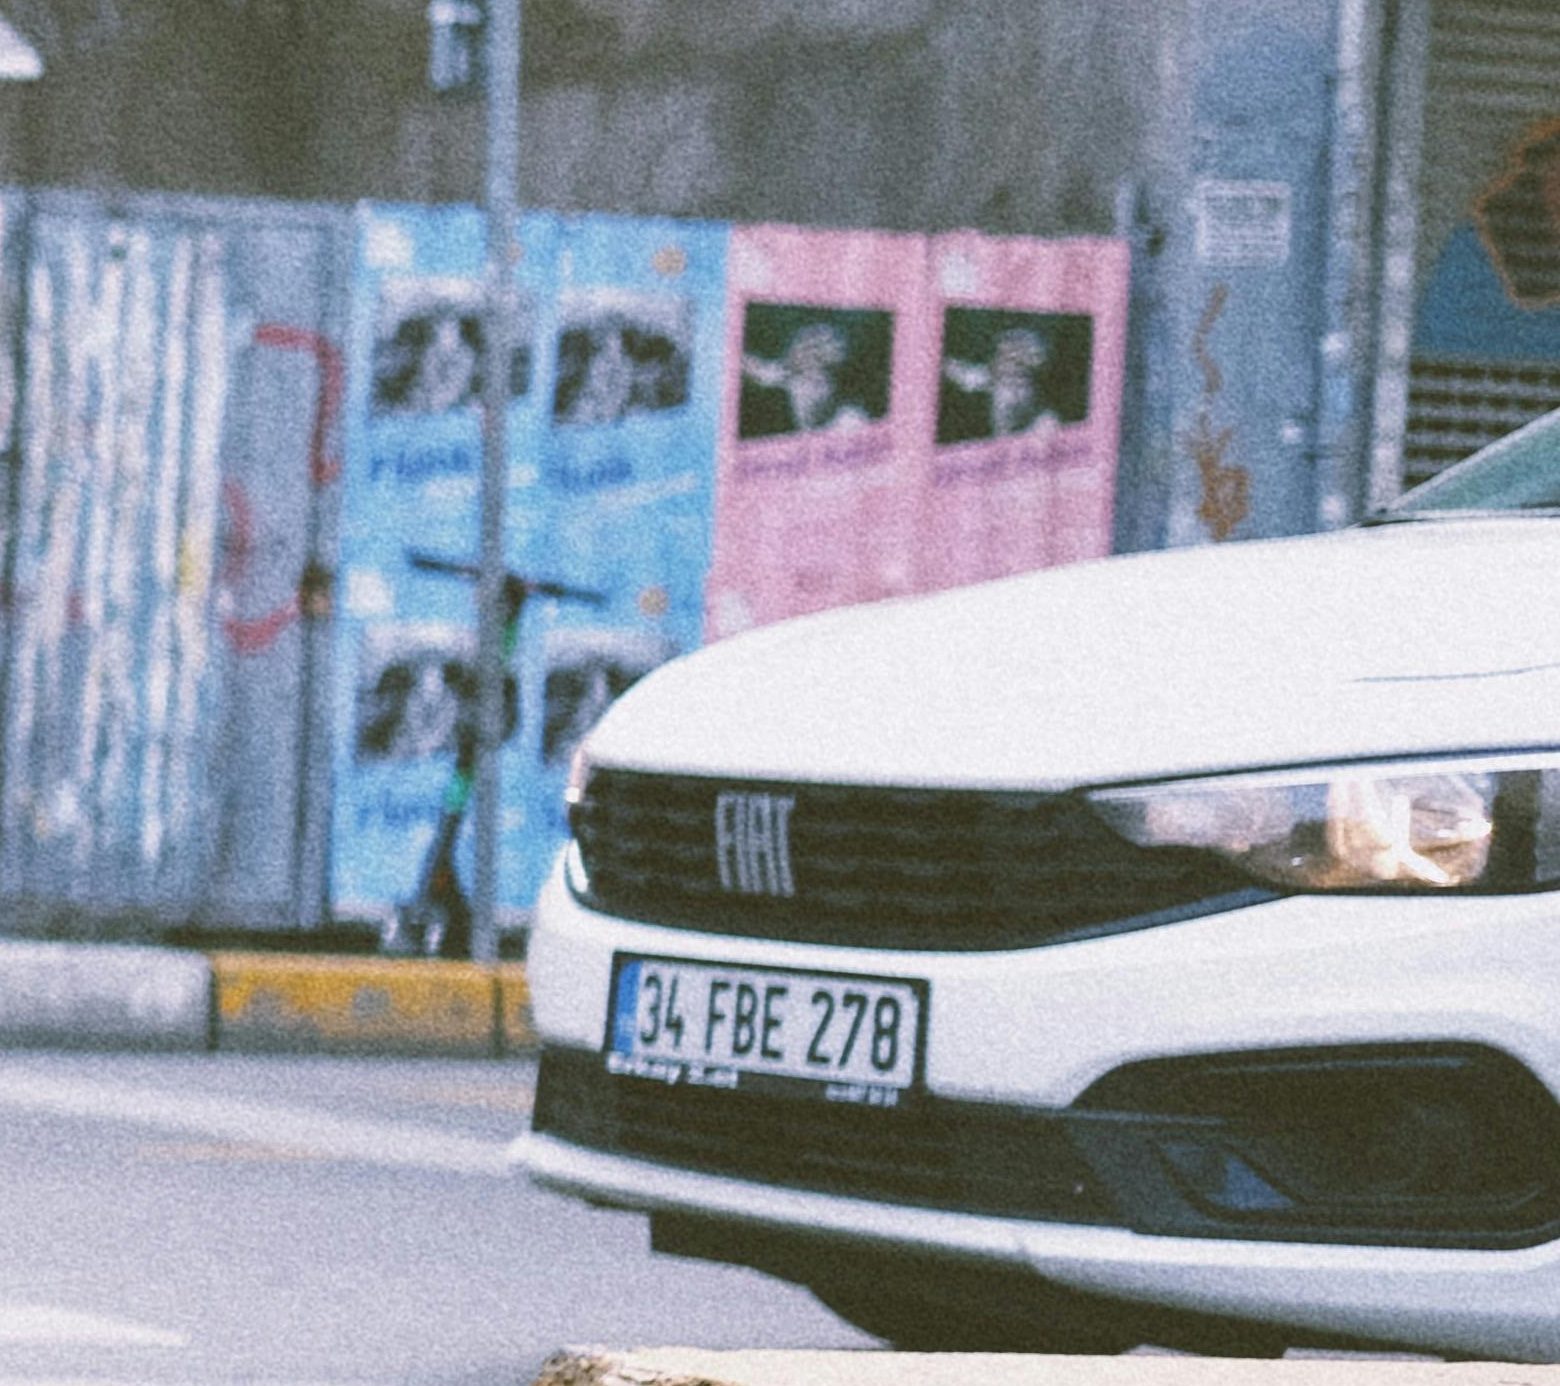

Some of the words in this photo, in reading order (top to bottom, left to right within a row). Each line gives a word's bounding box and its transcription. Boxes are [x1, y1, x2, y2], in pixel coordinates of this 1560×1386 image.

[715, 791, 796, 898] FIAT
[639, 973, 685, 1048] 34
[704, 979, 789, 1060] FBE
[806, 989, 902, 1073] 278
